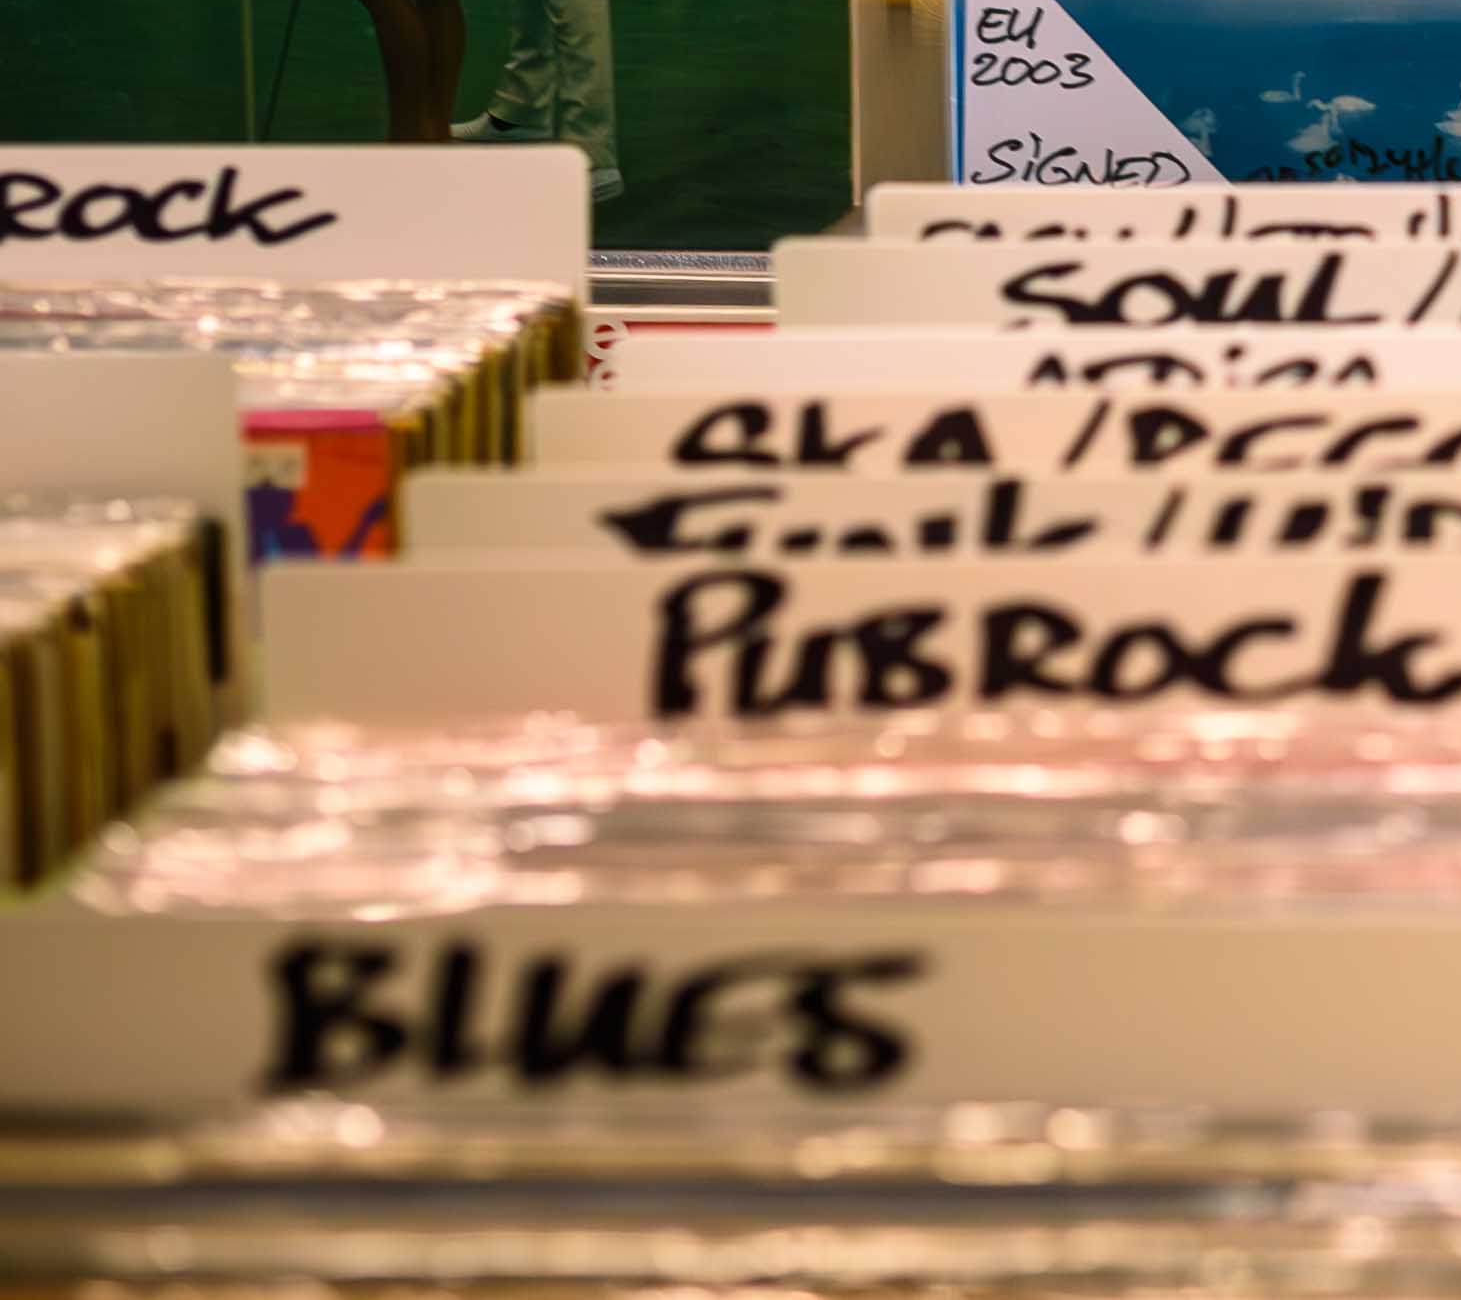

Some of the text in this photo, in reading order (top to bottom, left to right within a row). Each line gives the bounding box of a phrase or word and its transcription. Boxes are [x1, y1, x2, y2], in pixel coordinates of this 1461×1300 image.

[976, 6, 1045, 50] EU
[969, 51, 1097, 89] 2003
[260, 934, 938, 1095] BLUES
